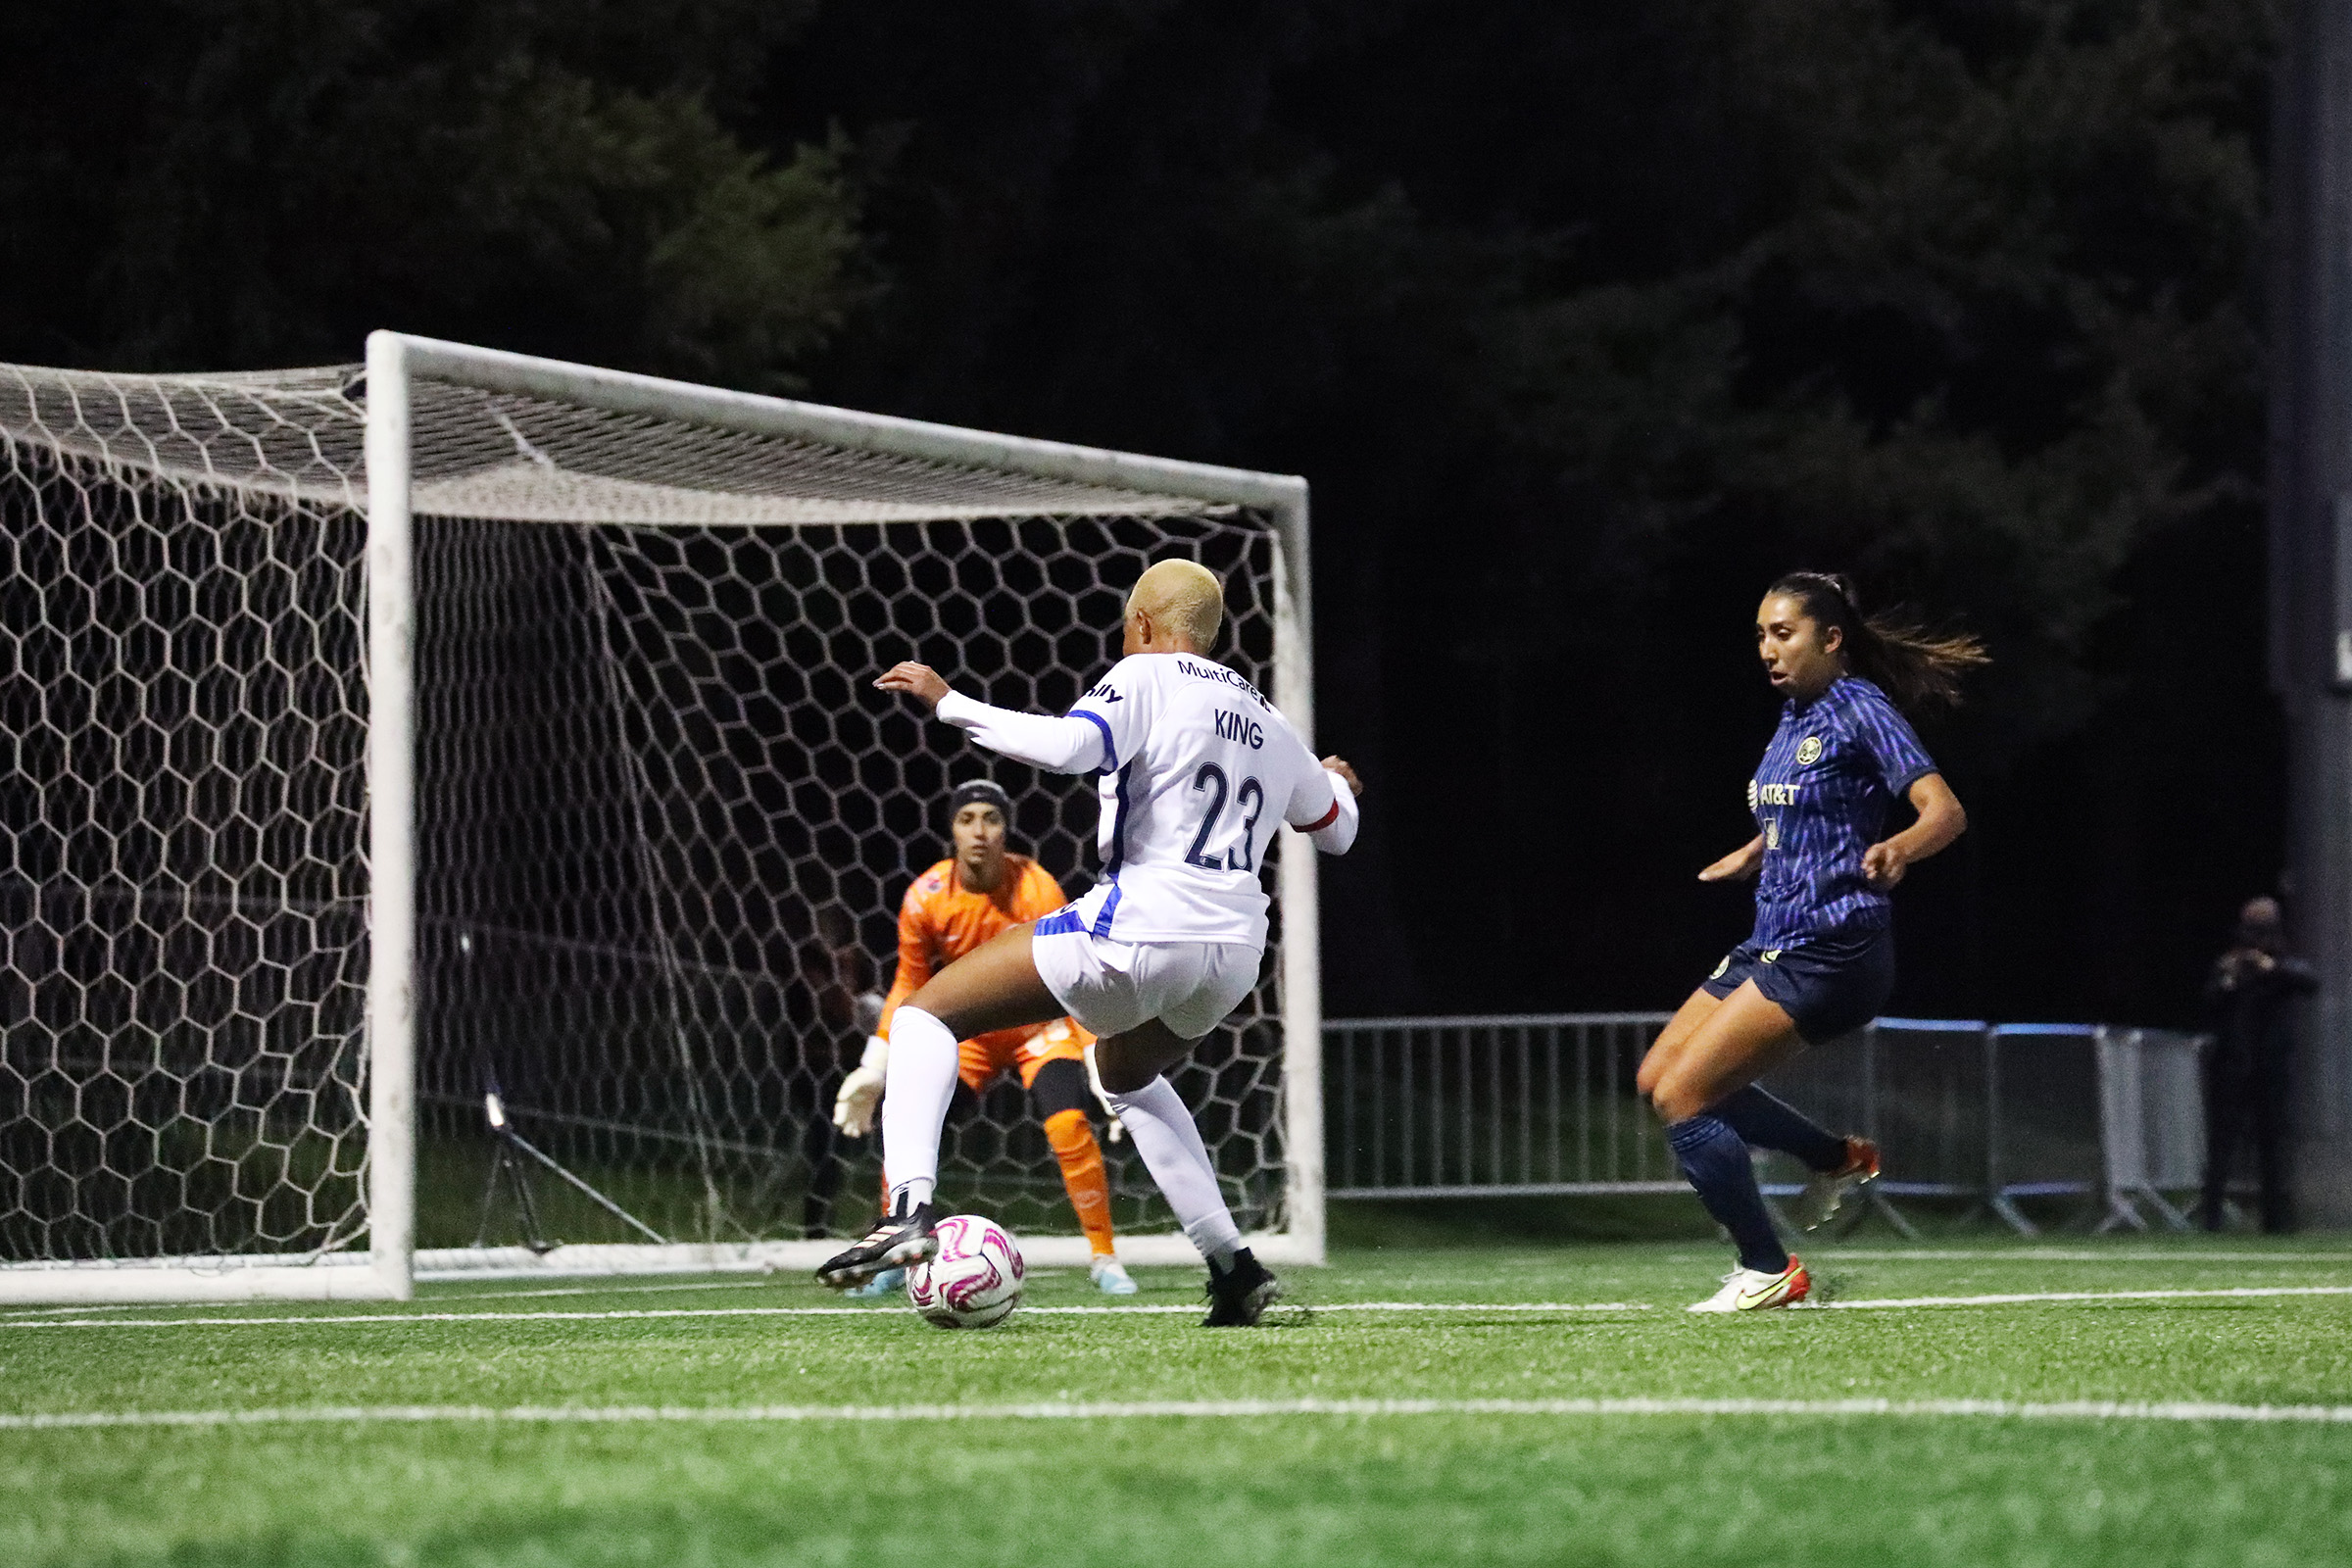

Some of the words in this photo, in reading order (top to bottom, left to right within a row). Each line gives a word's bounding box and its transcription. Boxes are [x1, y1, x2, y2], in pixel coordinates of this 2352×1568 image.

[1177, 660, 1258, 701] MultiCare
[1214, 708, 1265, 751] KING
[1760, 783, 1801, 806] AT&T
[1183, 760, 1265, 873] 23
